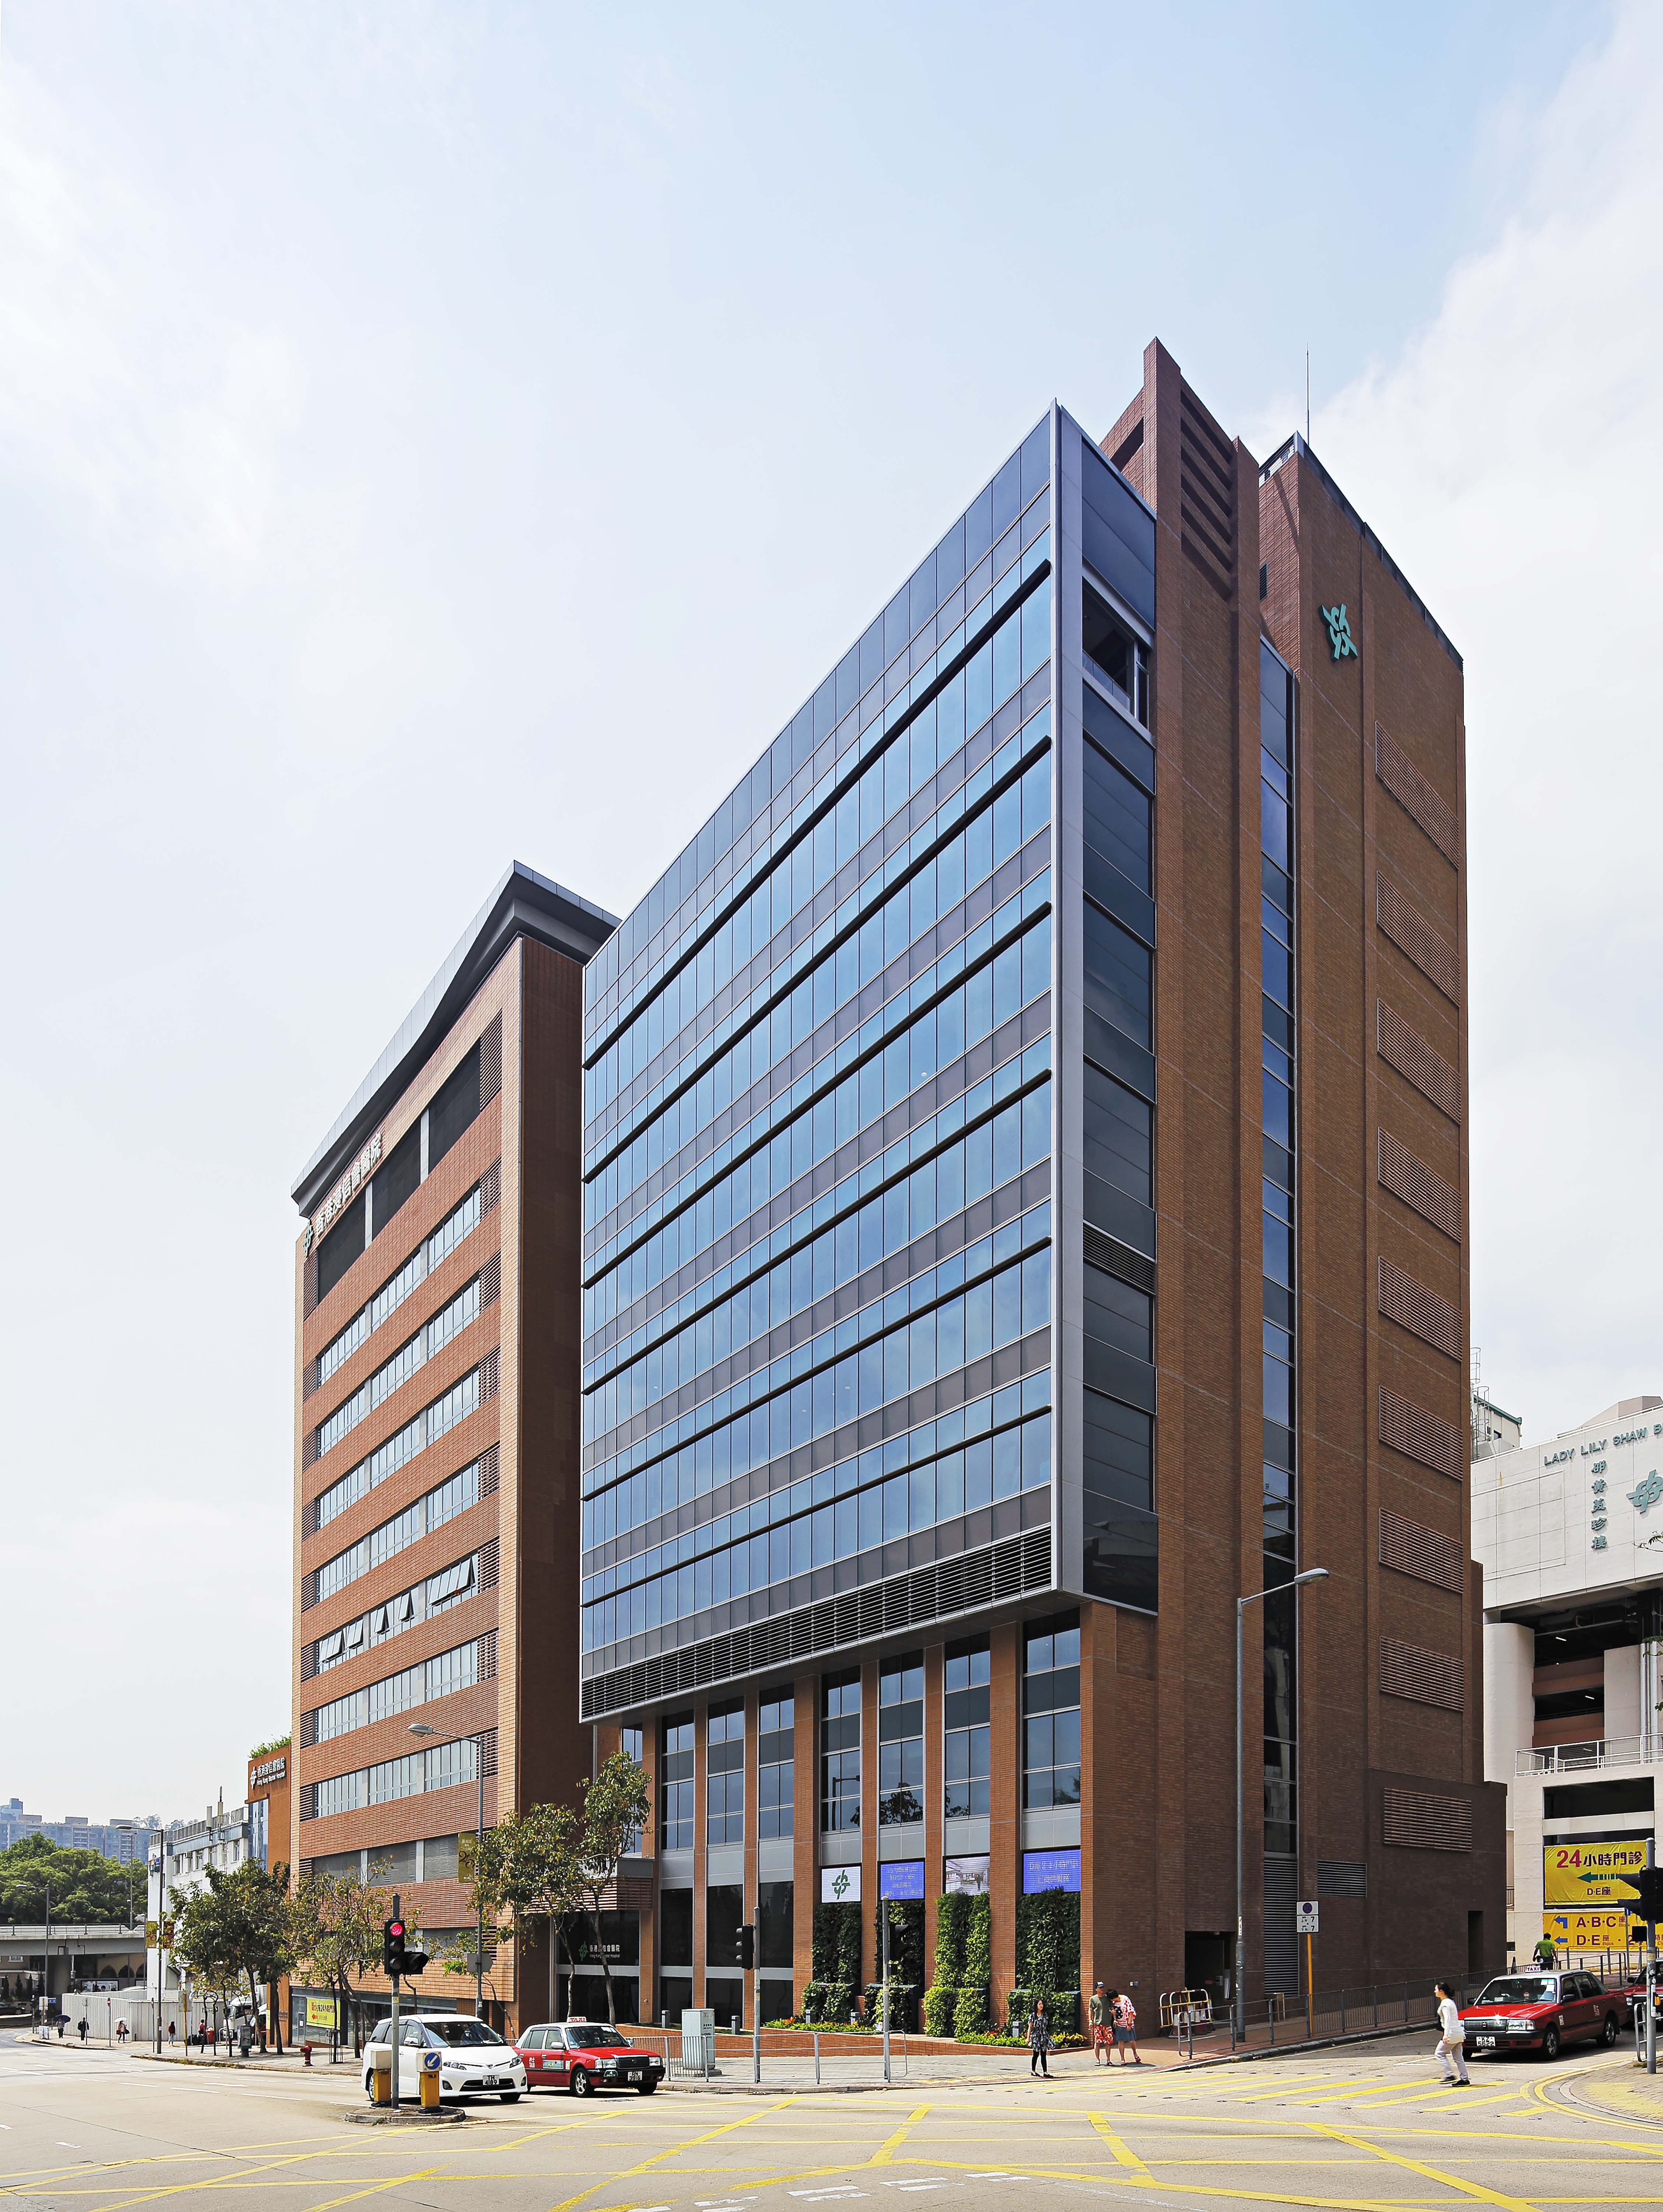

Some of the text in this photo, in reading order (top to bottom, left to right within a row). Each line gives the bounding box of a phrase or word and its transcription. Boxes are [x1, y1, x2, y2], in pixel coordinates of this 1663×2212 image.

[316, 1132, 382, 1237] 香港浸信會醫院
[1544, 1422, 1663, 1465] LADY LILY SHAW B
[1557, 1849, 1643, 1868] 24小時門診
